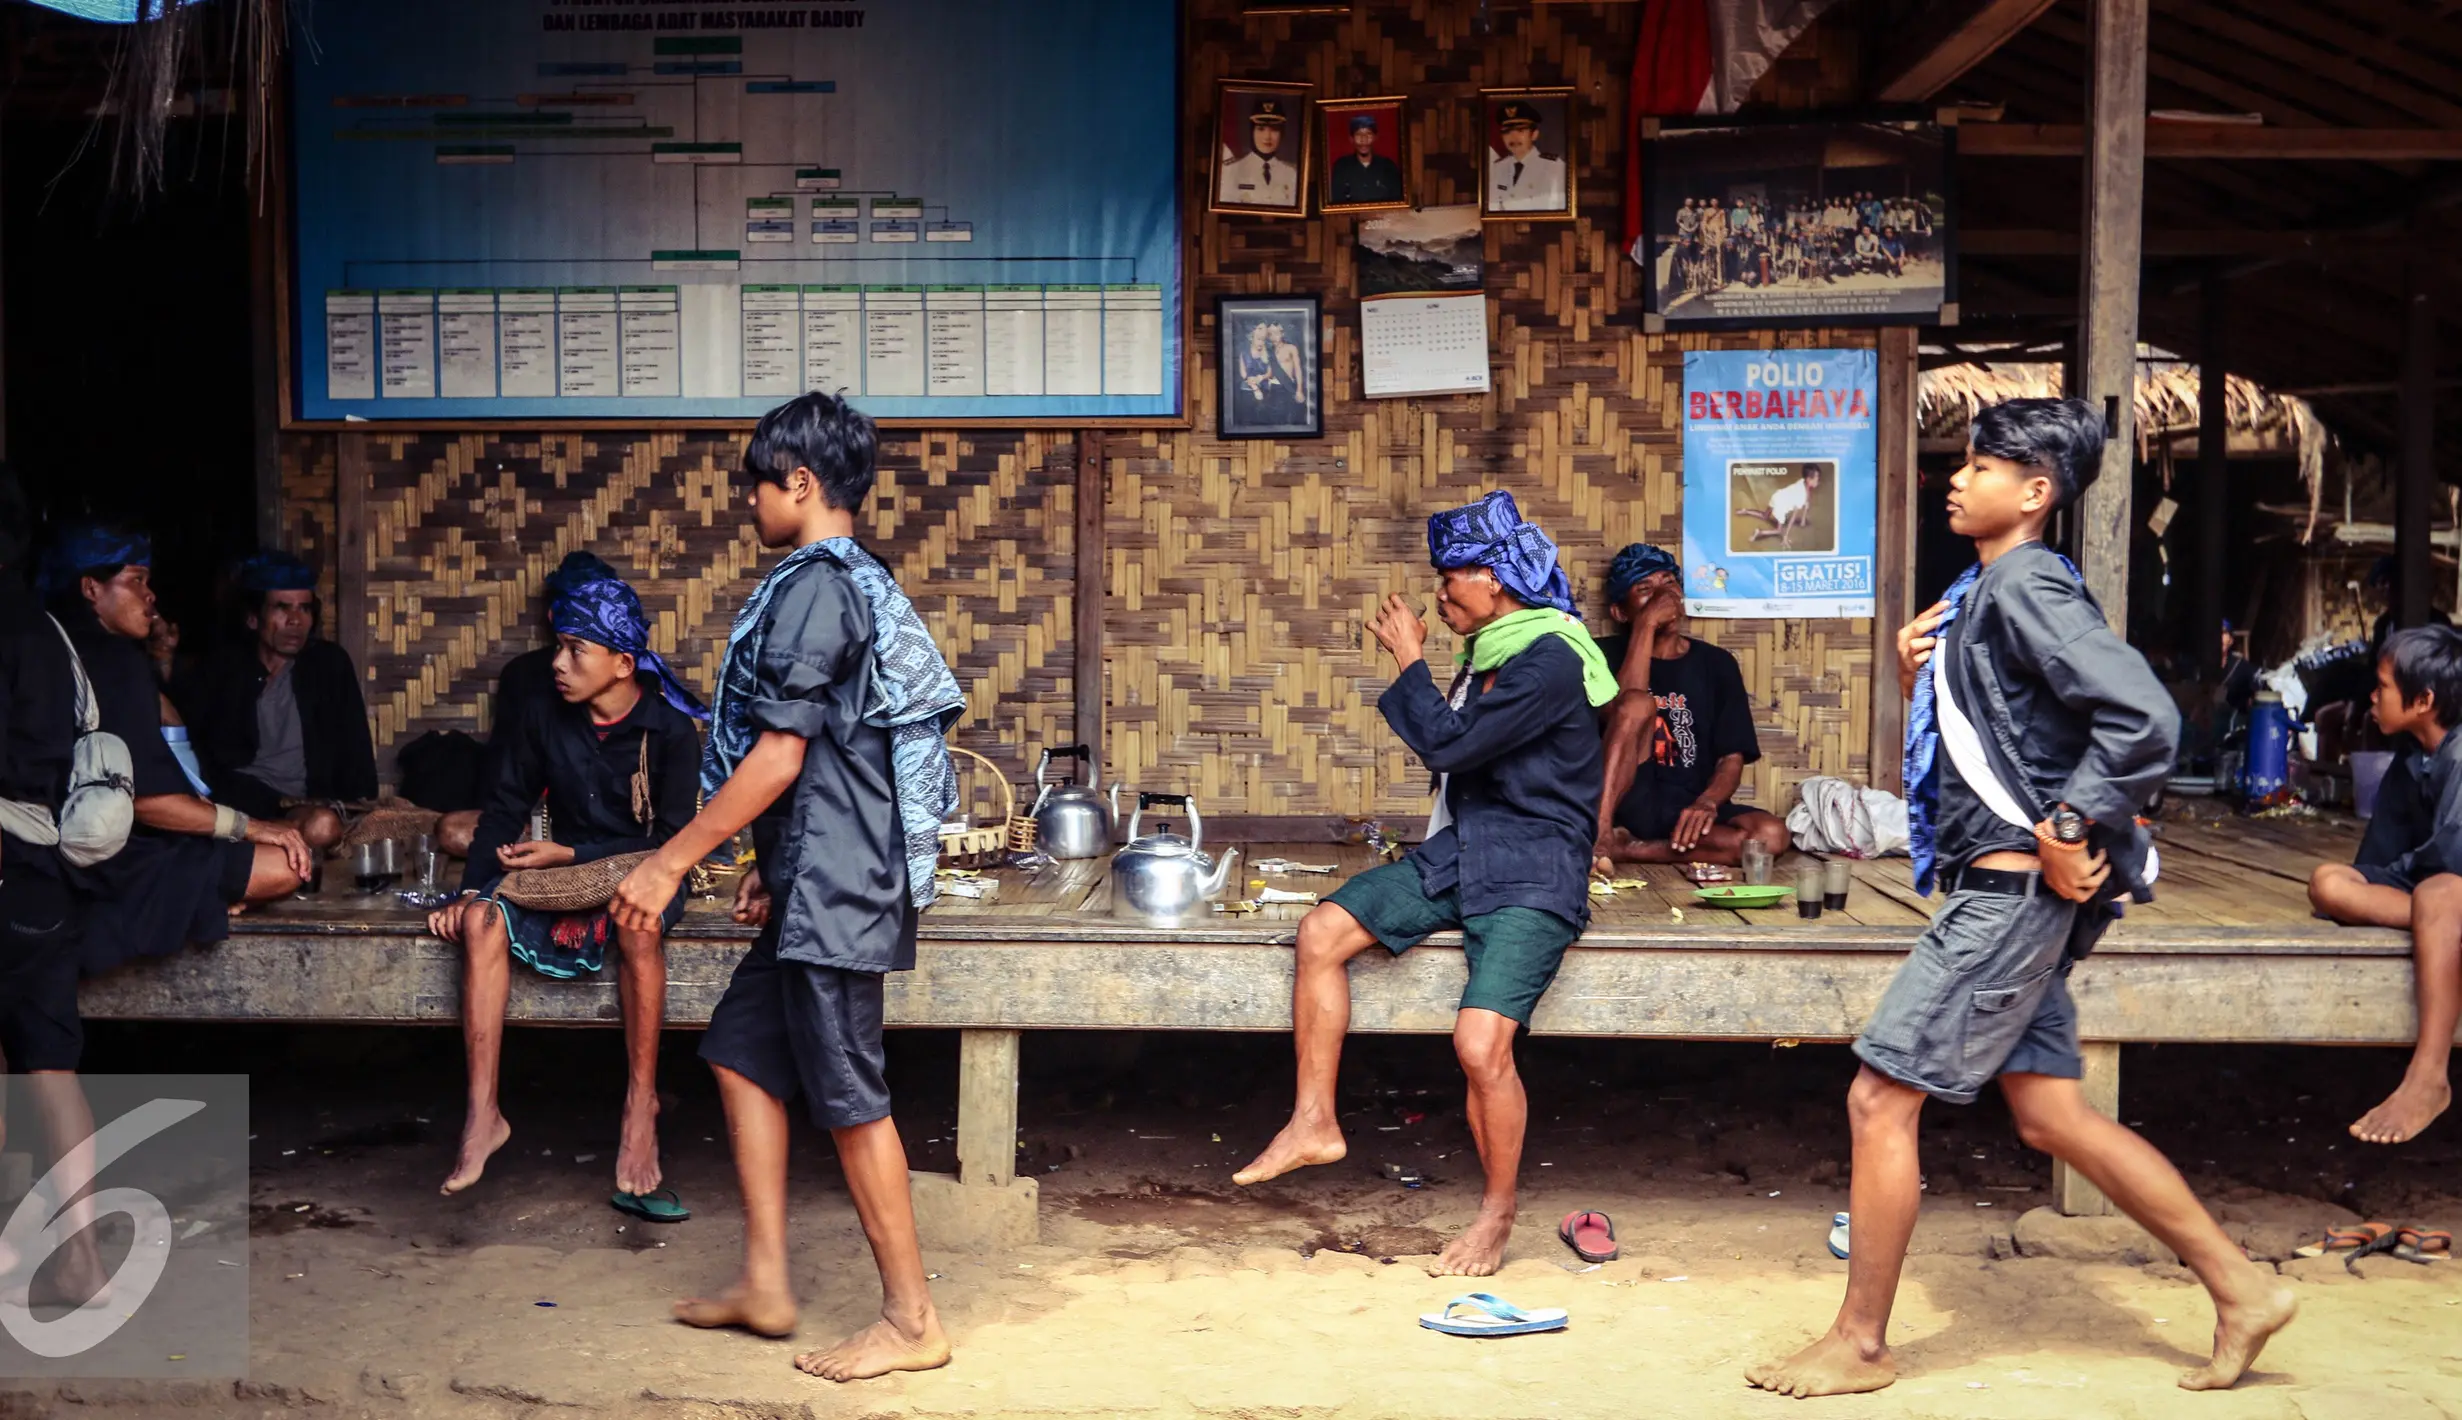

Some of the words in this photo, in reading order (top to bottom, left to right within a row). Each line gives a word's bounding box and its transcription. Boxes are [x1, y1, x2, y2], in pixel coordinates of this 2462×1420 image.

[543, 13, 574, 30] DAN
[579, 13, 652, 30] LEMBAGA
[656, 12, 697, 29] ADAT
[701, 10, 806, 28] MASYARAKAT
[811, 10, 864, 27] BADUY
[1747, 363, 1822, 387] POLIO
[1689, 388, 1870, 419] BERBAHAYA
[1761, 422, 1785, 430] ANDA
[1766, 467, 1788, 476] POLIO
[1781, 563, 1861, 581] GRATIS!
[1805, 580, 1839, 591] MARET
[1842, 578, 1865, 589] 2016
